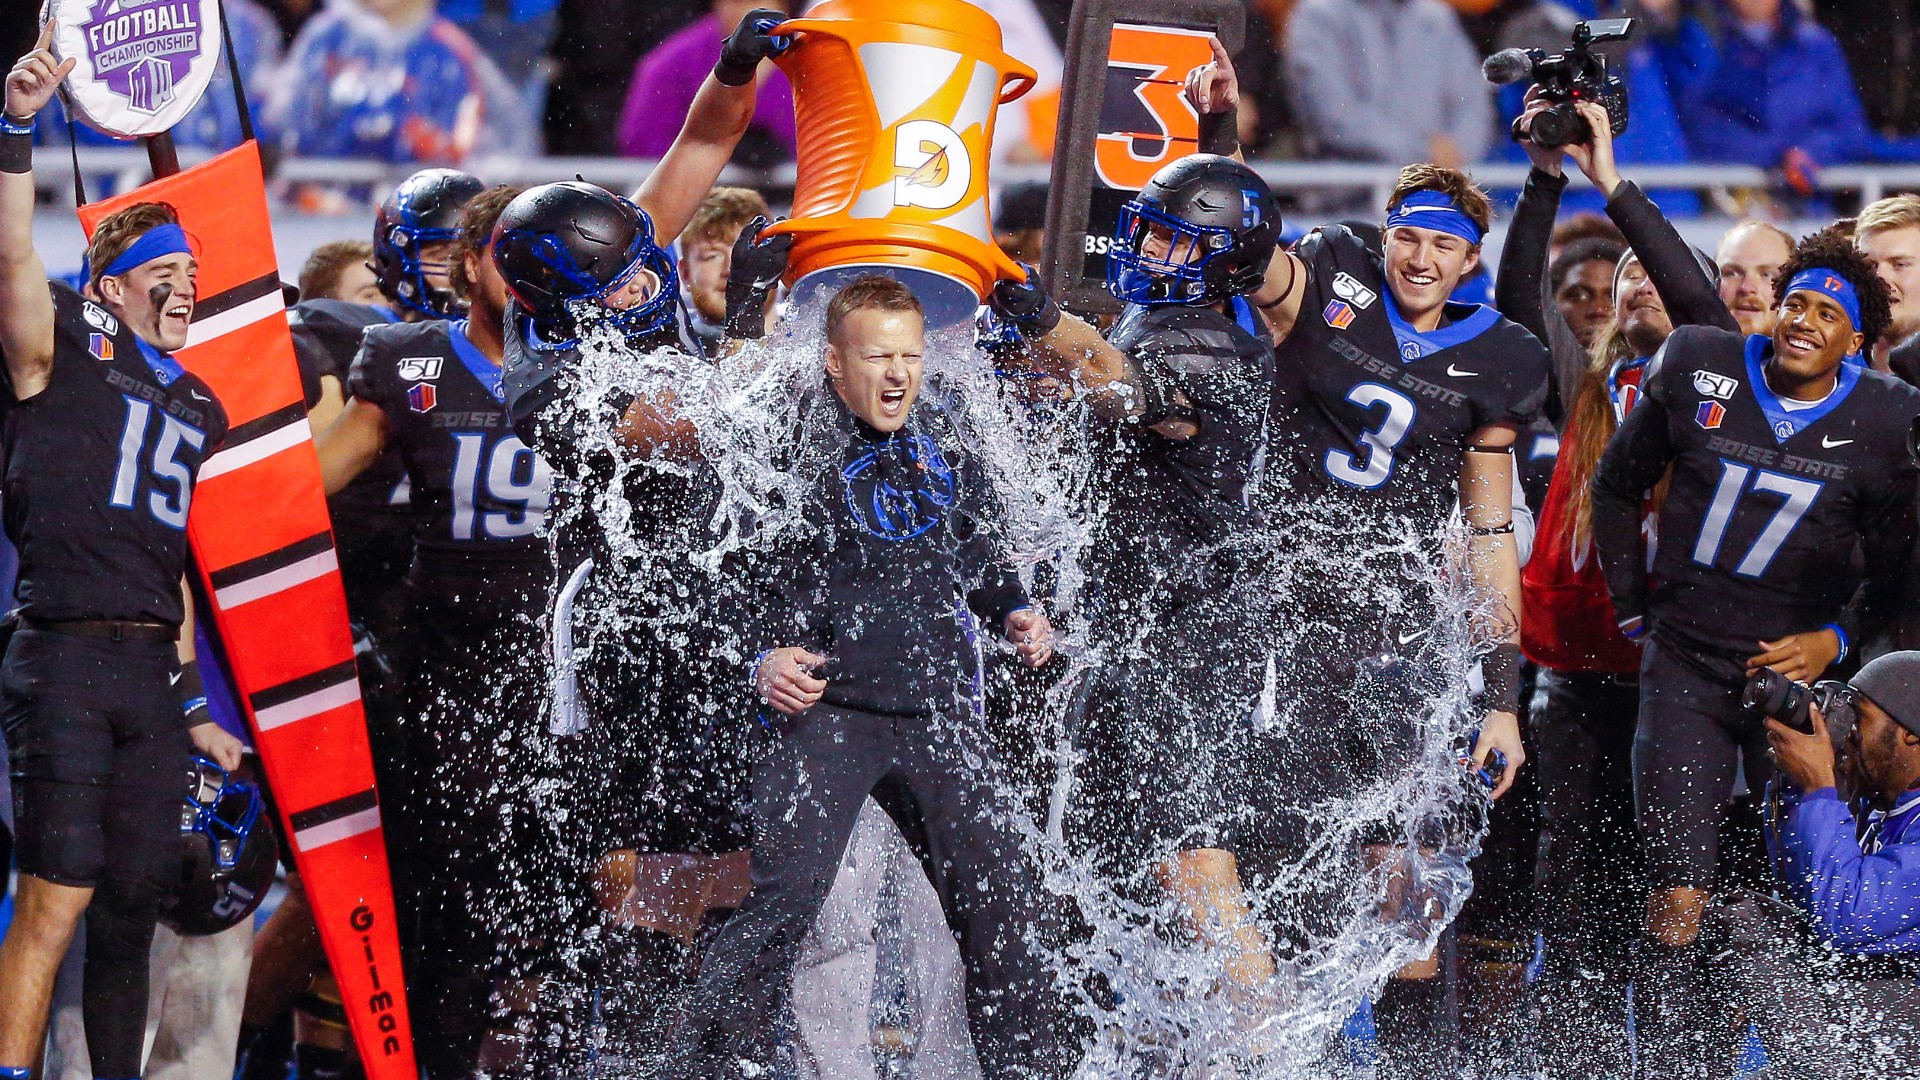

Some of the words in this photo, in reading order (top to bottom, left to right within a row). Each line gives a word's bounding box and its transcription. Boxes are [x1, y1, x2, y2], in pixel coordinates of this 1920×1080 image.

[89, 3, 197, 52] FOOTBALL
[100, 35, 194, 68] CHAMPIONSHIP
[1094, 22, 1217, 192] 3
[893, 119, 971, 210] G
[1240, 189, 1261, 228] 5
[1332, 270, 1378, 311] 150
[1824, 276, 1843, 292] 17
[82, 300, 119, 336] 150
[105, 368, 167, 406] BOISE
[397, 356, 444, 381] 150
[1328, 334, 1399, 380] BOISE
[1398, 372, 1468, 407] STATE
[1692, 369, 1740, 400] 150
[1323, 381, 1417, 490] 3
[1705, 434, 1779, 466] BOISE
[1780, 454, 1849, 480] STATE
[109, 393, 207, 531] 15
[450, 432, 554, 541] 19
[1692, 457, 1826, 580] 17
[350, 905, 401, 1057] Gilman
